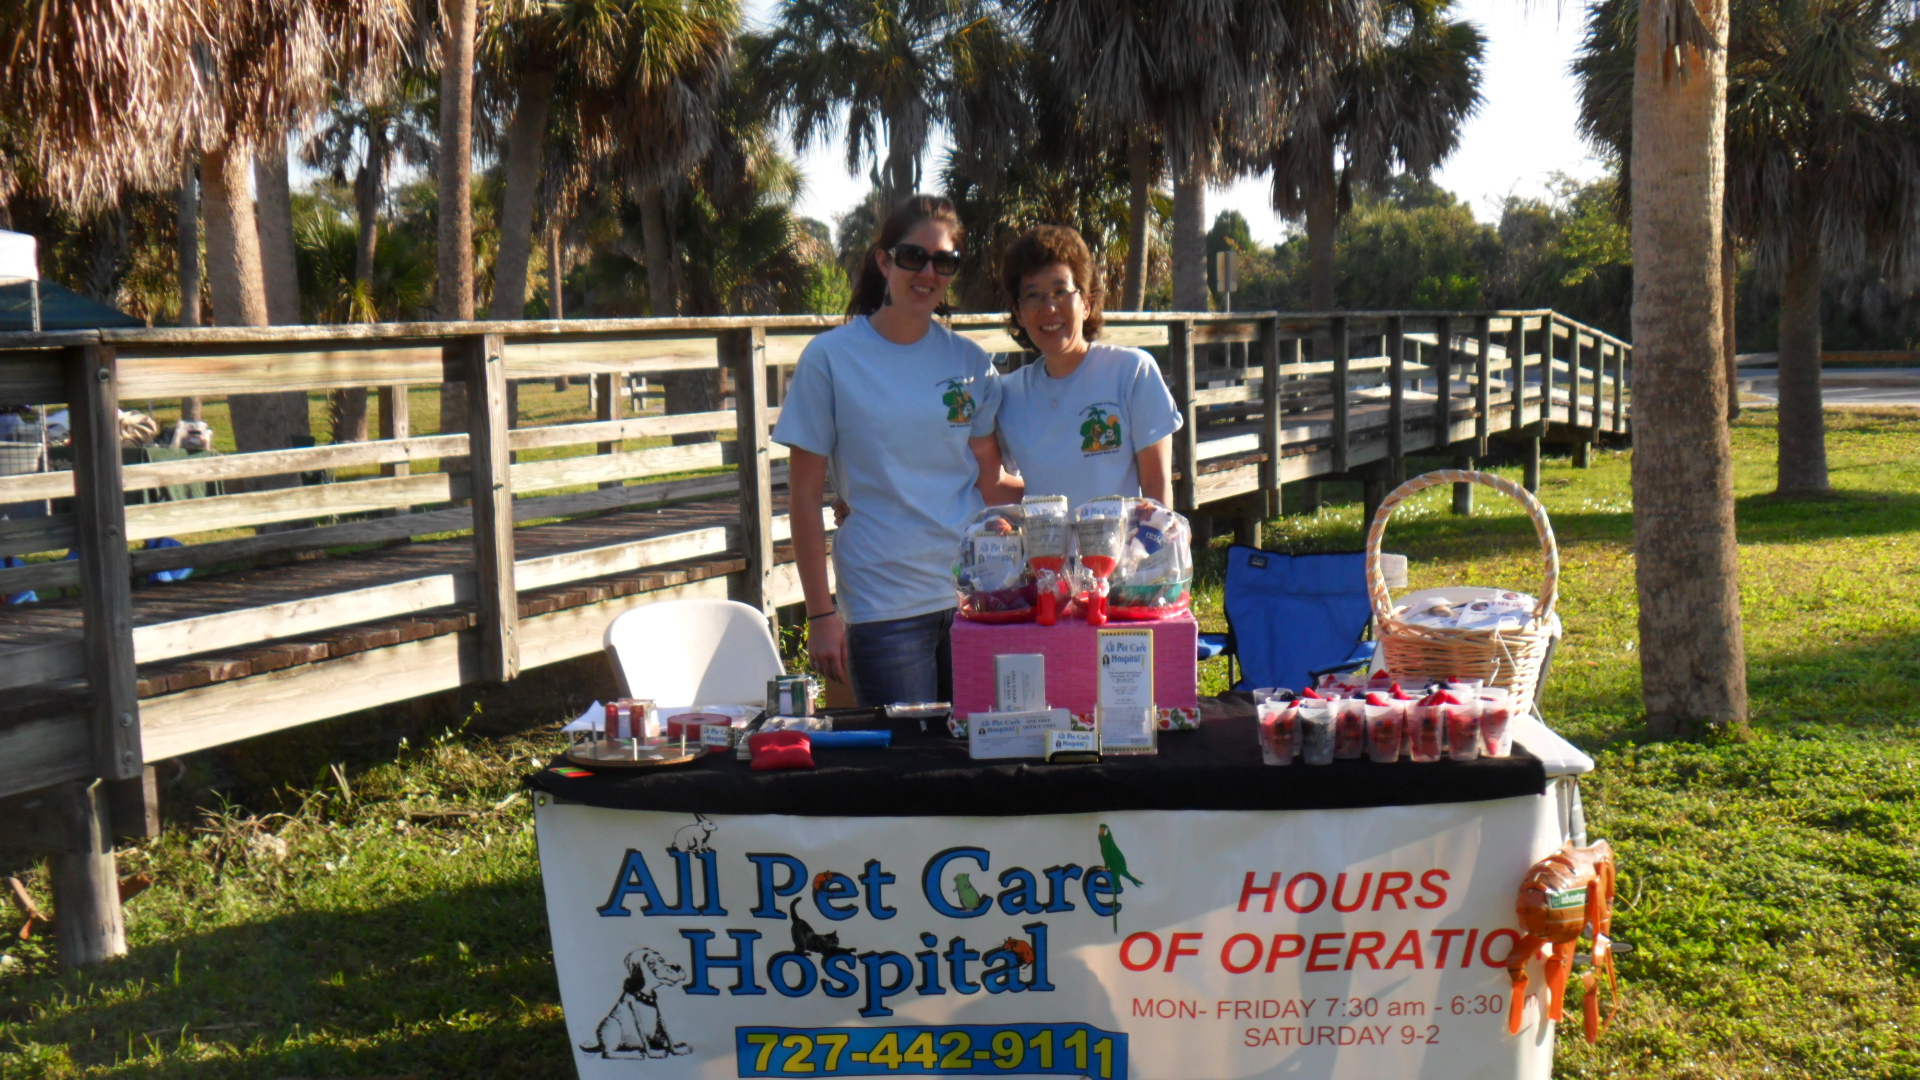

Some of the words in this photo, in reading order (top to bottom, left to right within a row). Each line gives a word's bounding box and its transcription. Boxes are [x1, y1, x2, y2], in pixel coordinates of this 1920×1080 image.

[1105, 642, 1115, 652] All
[1116, 642, 1128, 652] Pet
[1130, 643, 1147, 652] Care
[1111, 655, 1141, 665] Hospital
[981, 719, 990, 727] All
[992, 719, 1003, 727] Pet
[987, 726, 1015, 734] Hospital
[1058, 732, 1066, 740] All
[1067, 732, 1076, 740] Pet
[1062, 740, 1085, 748] Hospital
[596, 847, 728, 917] All
[745, 852, 898, 921] Pet
[921, 846, 1124, 919] Care
[1237, 869, 1451, 914] HOURS
[1119, 931, 1204, 973] OF
[1220, 928, 1524, 975] OPERATIO
[678, 921, 1056, 1018] Hospital
[1132, 998, 1208, 1019] MON-
[1217, 998, 1317, 1020] FRIDAY
[1326, 997, 1379, 1017] 7:30
[1387, 1000, 1425, 1017] am
[1450, 994, 1503, 1015] 6:30
[1244, 1024, 1392, 1047] SATURDAY
[1400, 1025, 1440, 1045] 9-2
[746, 1028, 1113, 1079] 727-442-9111
